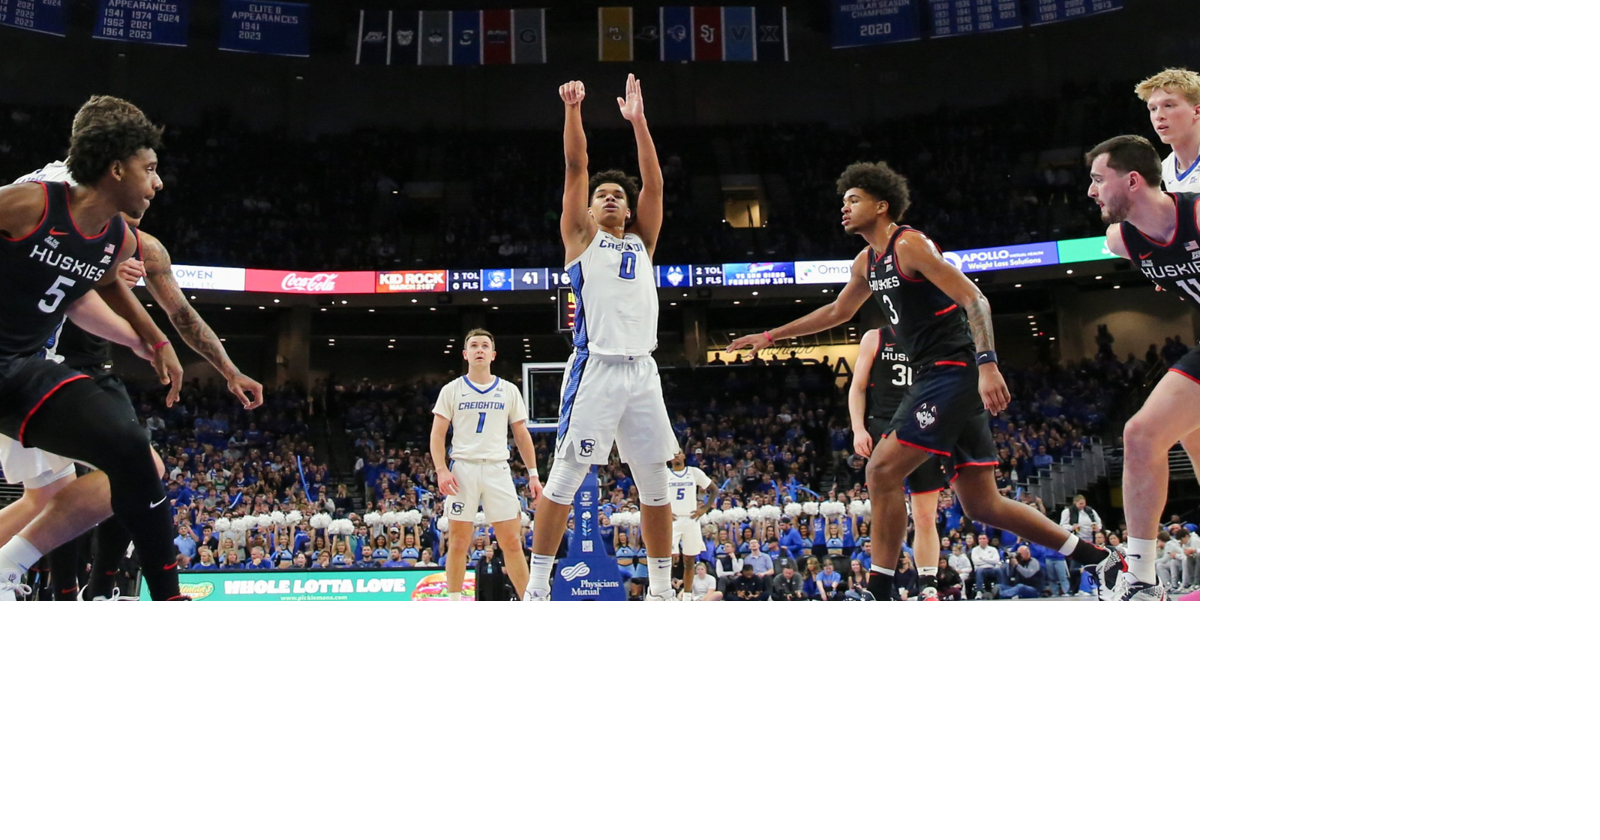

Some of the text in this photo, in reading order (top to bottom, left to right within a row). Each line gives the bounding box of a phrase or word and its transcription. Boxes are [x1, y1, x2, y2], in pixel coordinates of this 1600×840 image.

[17, 0, 34, 10] 2021
[108, 0, 178, 13] APPEARANCES
[249, 4, 273, 14] ELITE
[15, 8, 35, 19] 2022
[104, 8, 180, 23] 1941 1974 2024
[231, 10, 299, 25] APPEARANCES
[851, 7, 899, 19] CHAMPIONS
[14, 16, 34, 28] 2023
[103, 17, 152, 30] 1962 2021
[241, 21, 260, 31] 1941
[102, 27, 152, 40] 1964 2023
[238, 30, 261, 41] 2023
[860, 22, 891, 37] 2020
[961, 249, 1010, 263] APOLLO
[29, 244, 105, 282] HUSKIES
[618, 251, 637, 280] 0
[967, 261, 993, 270] Weight
[1009, 257, 1042, 266] Solutions
[1141, 260, 1200, 279] HUSKIE
[453, 272, 480, 280] 3 TOL
[695, 266, 723, 275] 2 TOL
[281, 272, 339, 291] Coca-Cola
[379, 272, 445, 285] KID ROCK
[522, 271, 539, 285] 41
[696, 276, 722, 285] 3 FLS
[728, 278, 771, 286] FEBRUARY
[868, 275, 900, 292] HUSKIES
[452, 282, 479, 290] 0 FLS
[38, 275, 76, 314] 5
[882, 294, 899, 325] 3
[458, 401, 505, 411] CREIGHTON
[476, 412, 486, 433] 1
[676, 488, 686, 500] 5
[224, 578, 406, 595] WHOLE LOTTA LOVE
[580, 579, 619, 589] Physicians
[571, 588, 600, 596] Mutual
